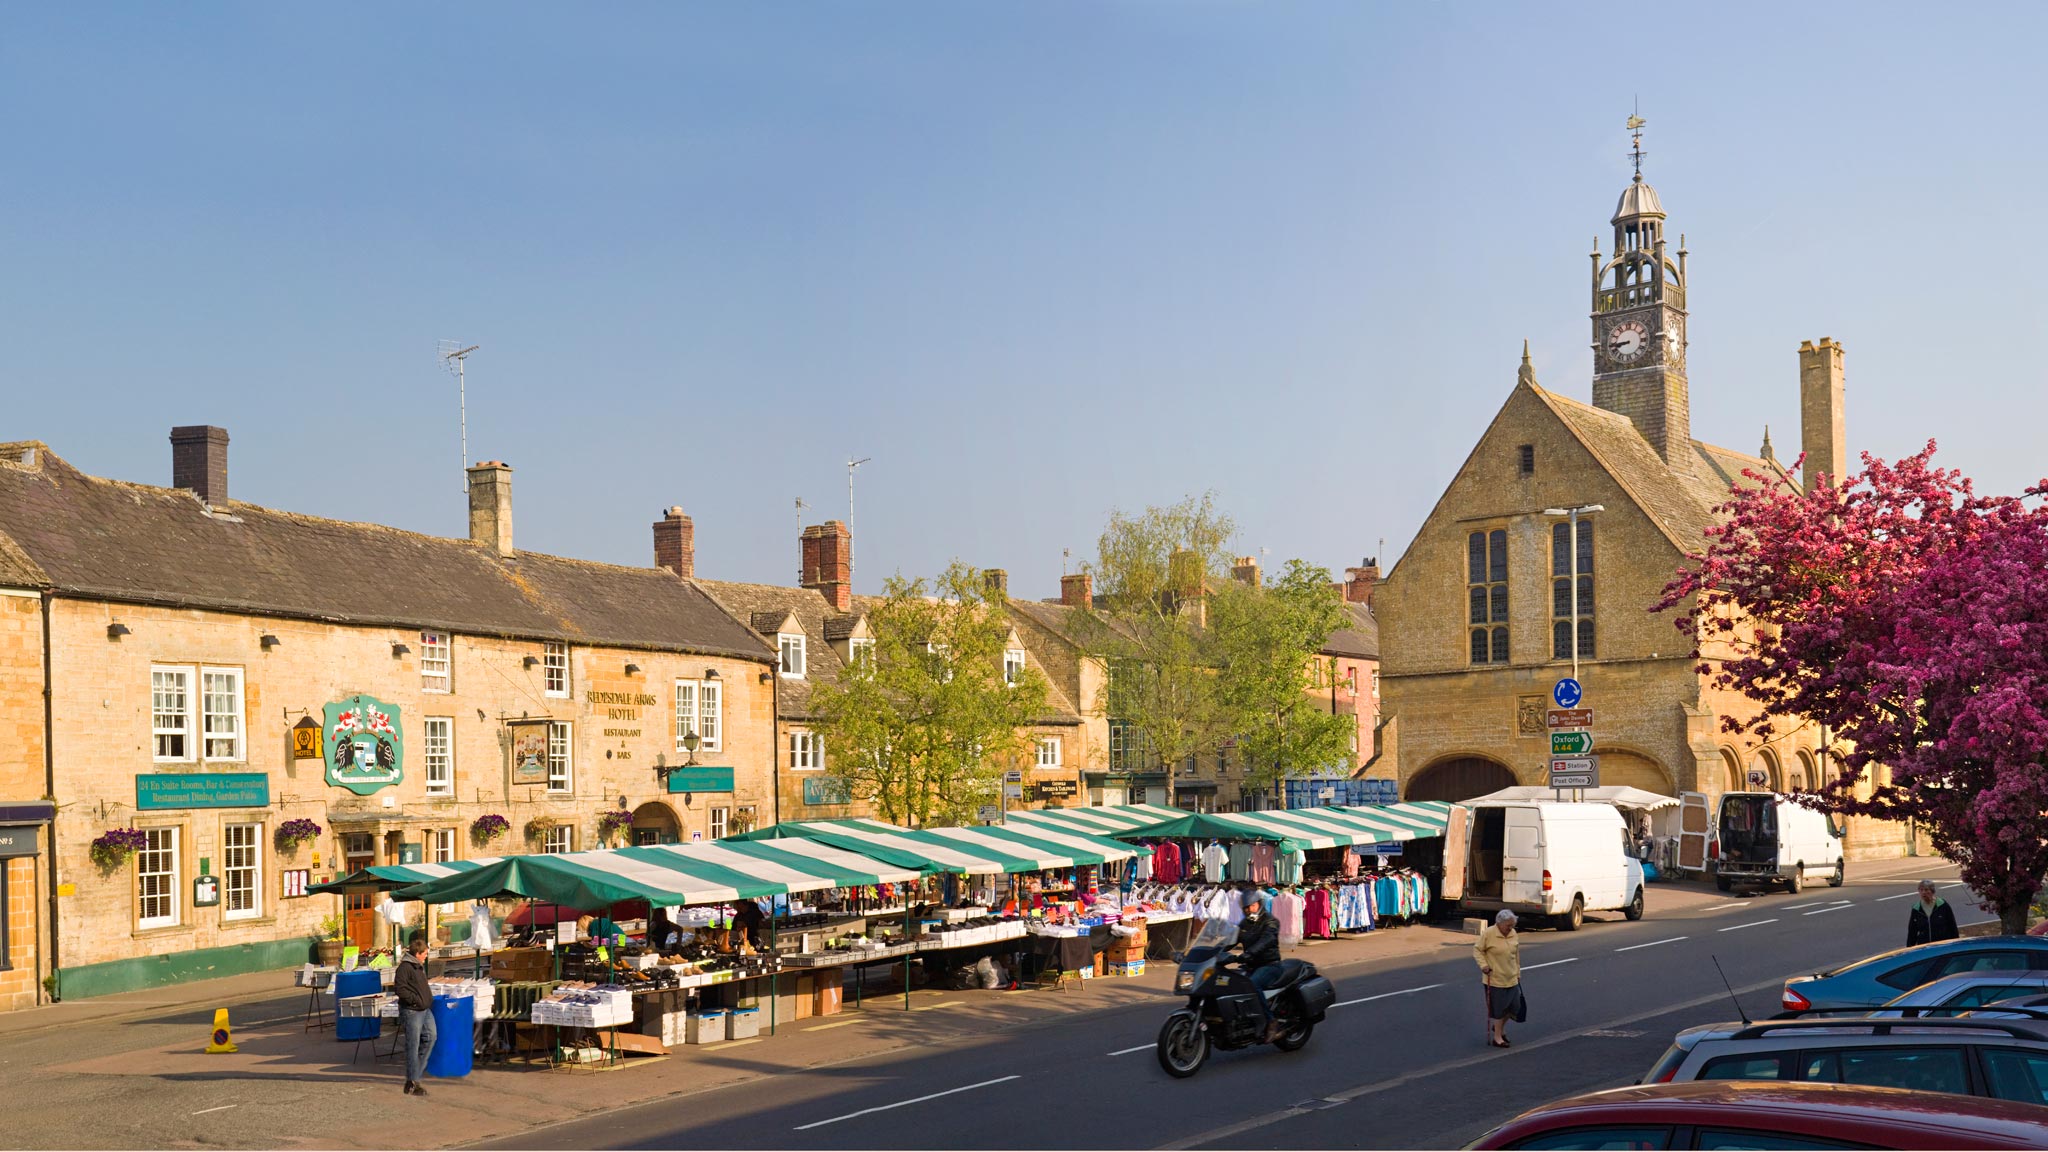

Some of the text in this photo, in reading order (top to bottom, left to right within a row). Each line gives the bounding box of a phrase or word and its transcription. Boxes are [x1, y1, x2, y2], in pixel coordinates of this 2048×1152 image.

[634, 693, 656, 706] ARMS
[608, 708, 637, 720] HOTEL
[604, 728, 642, 737] RESTAURANT
[620, 740, 626, 748] &
[617, 751, 632, 760] BARS
